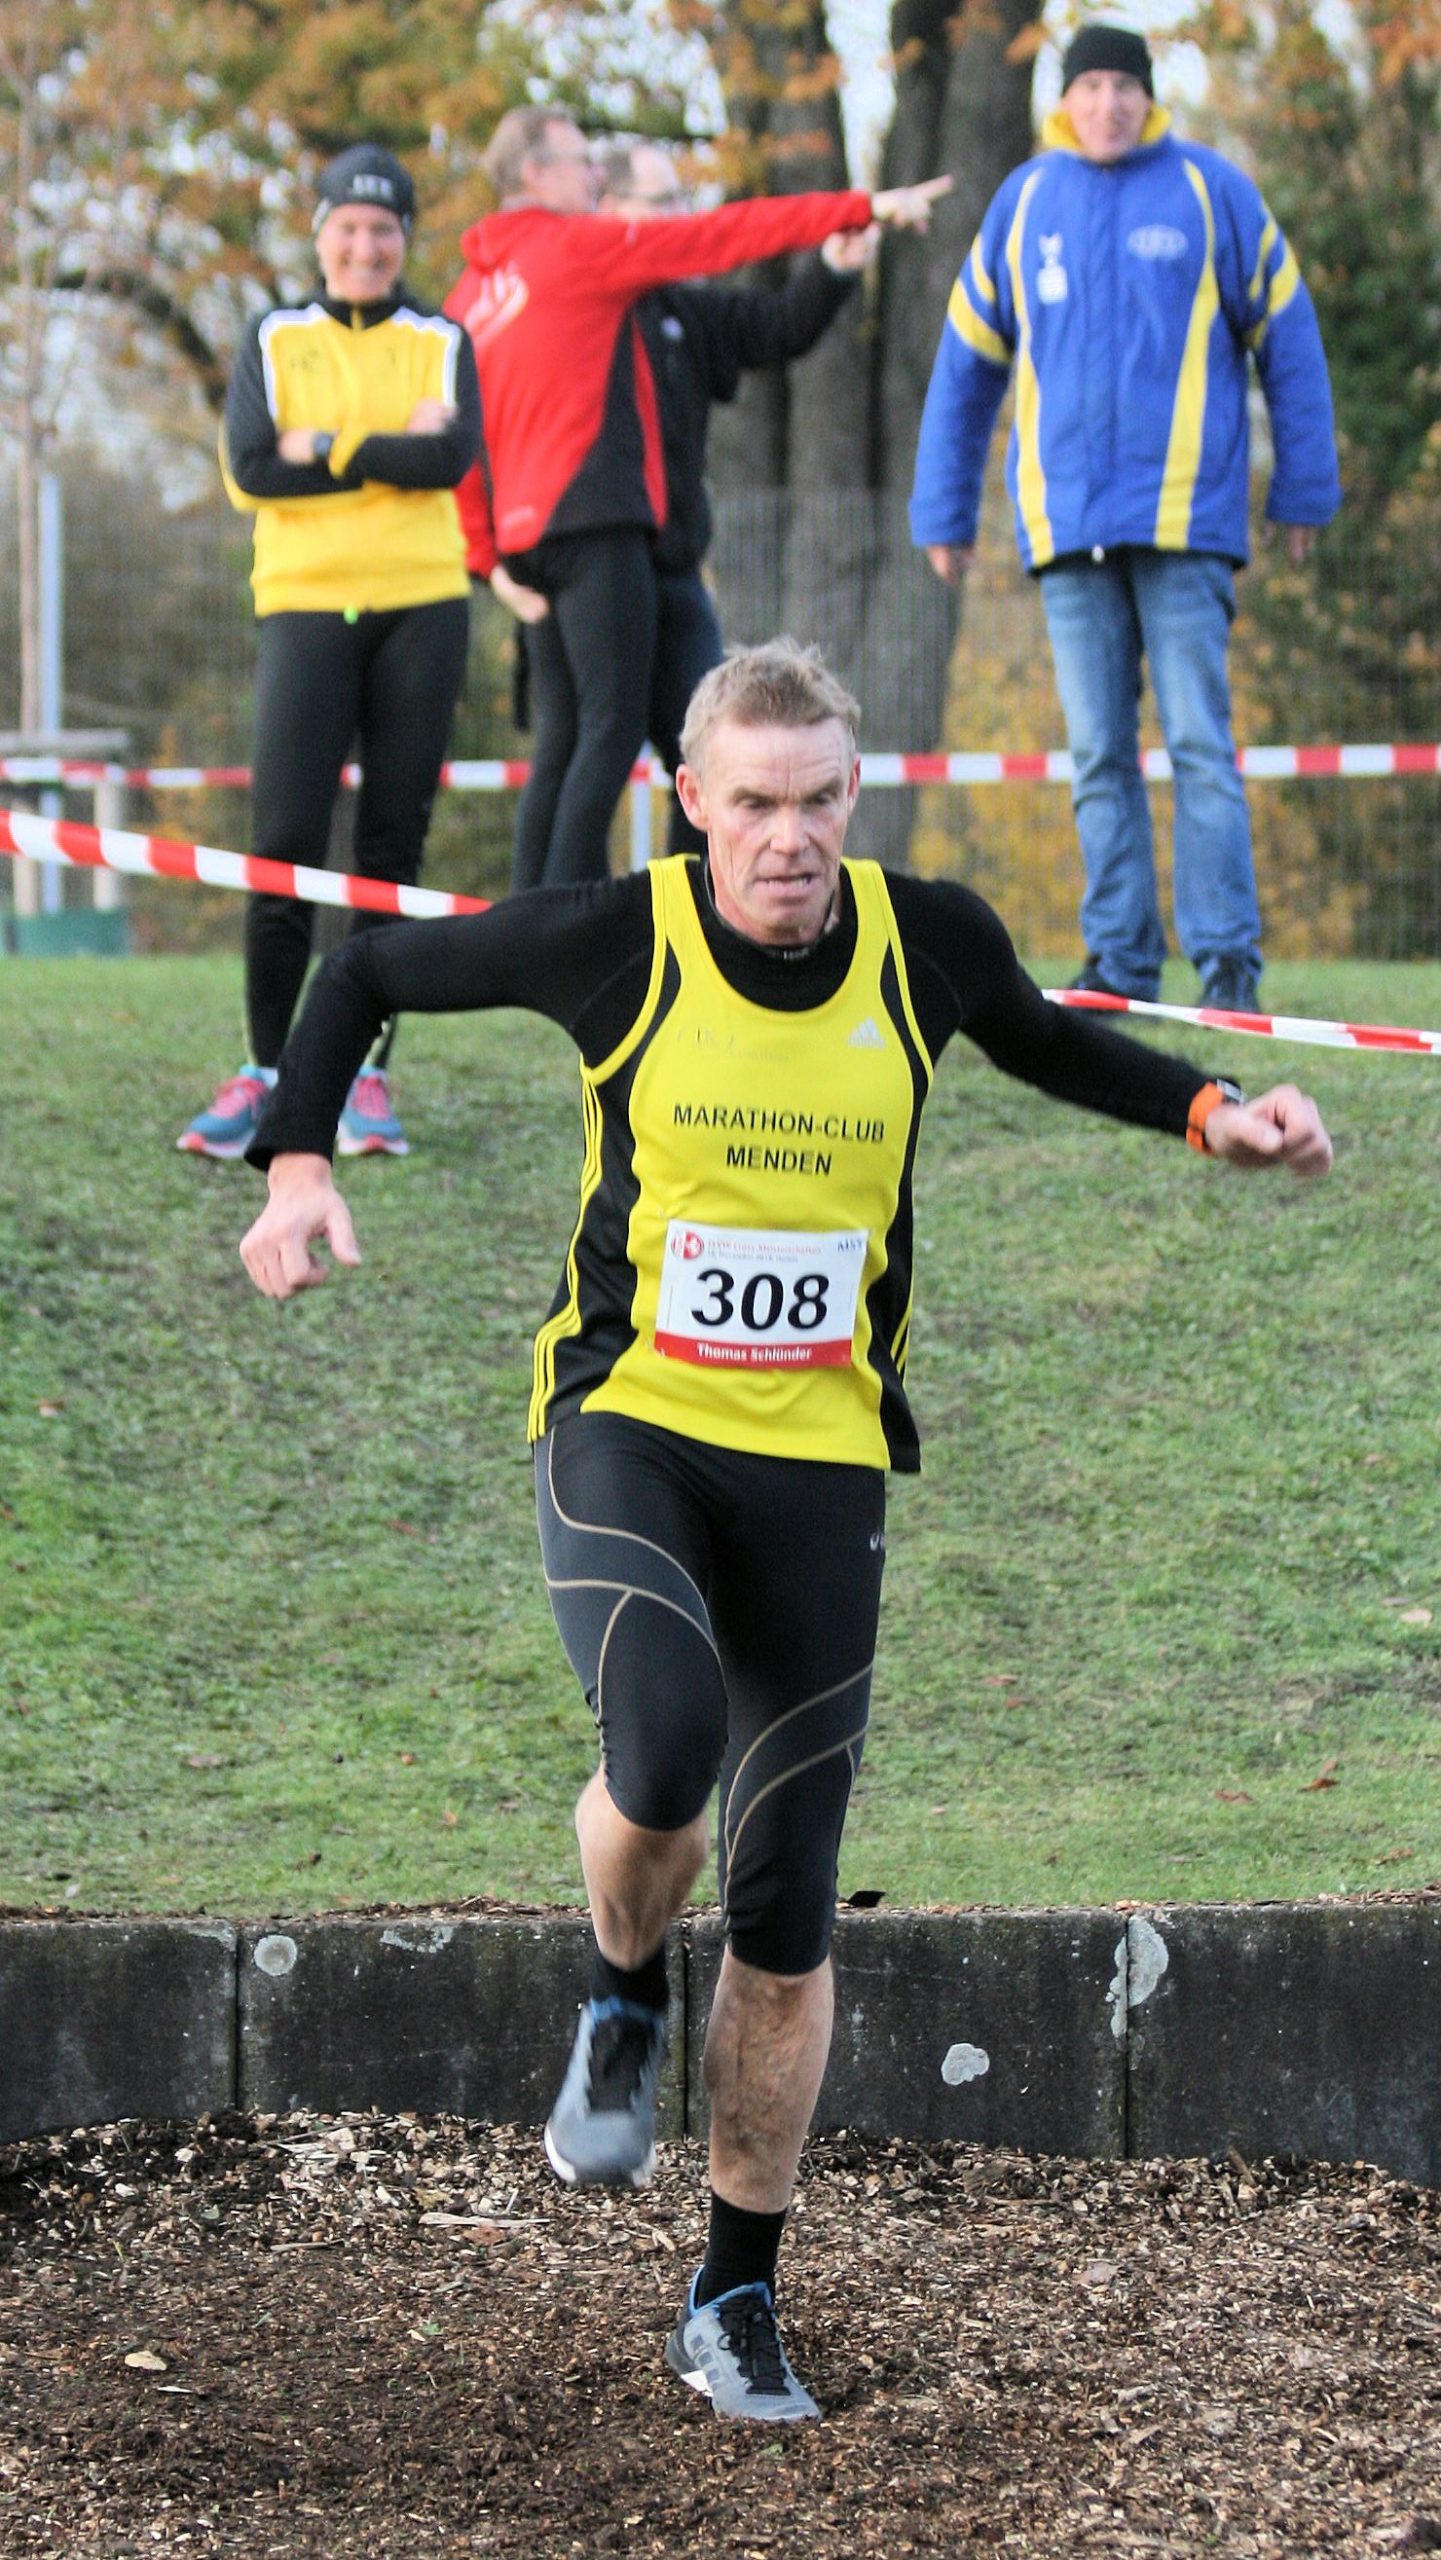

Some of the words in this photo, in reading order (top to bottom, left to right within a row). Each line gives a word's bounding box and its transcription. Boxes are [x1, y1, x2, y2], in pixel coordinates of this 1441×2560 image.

[673, 1103, 885, 1144] MARATHON-CLUB
[726, 1145, 833, 1176] MENDEN
[691, 1268, 830, 1331] 308
[697, 1342, 747, 1361] Thomas
[750, 1345, 813, 1363] Schlünder
